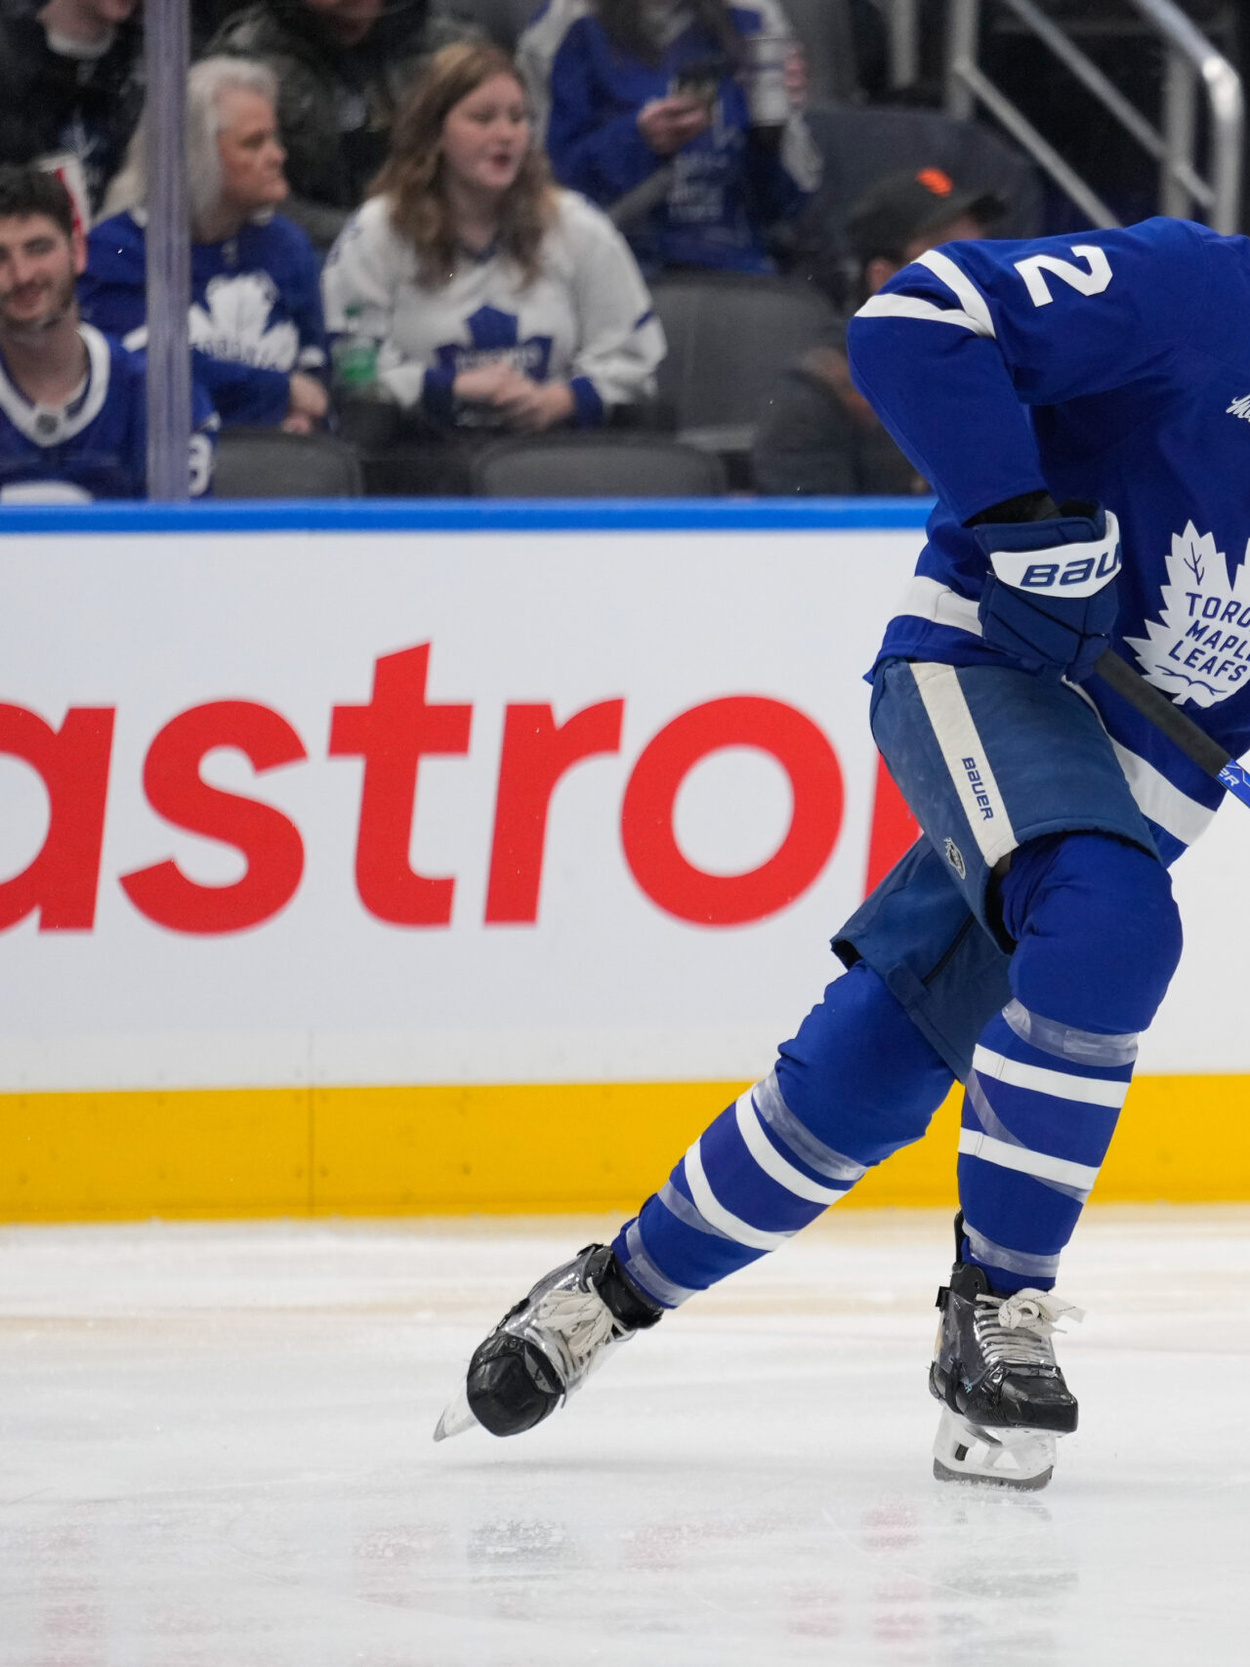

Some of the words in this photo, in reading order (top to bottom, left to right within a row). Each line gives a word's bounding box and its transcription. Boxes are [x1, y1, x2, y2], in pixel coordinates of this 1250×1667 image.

[1013, 244, 1113, 307] 2
[1168, 640, 1247, 681] LEAFS
[962, 757, 994, 820] BAUER
